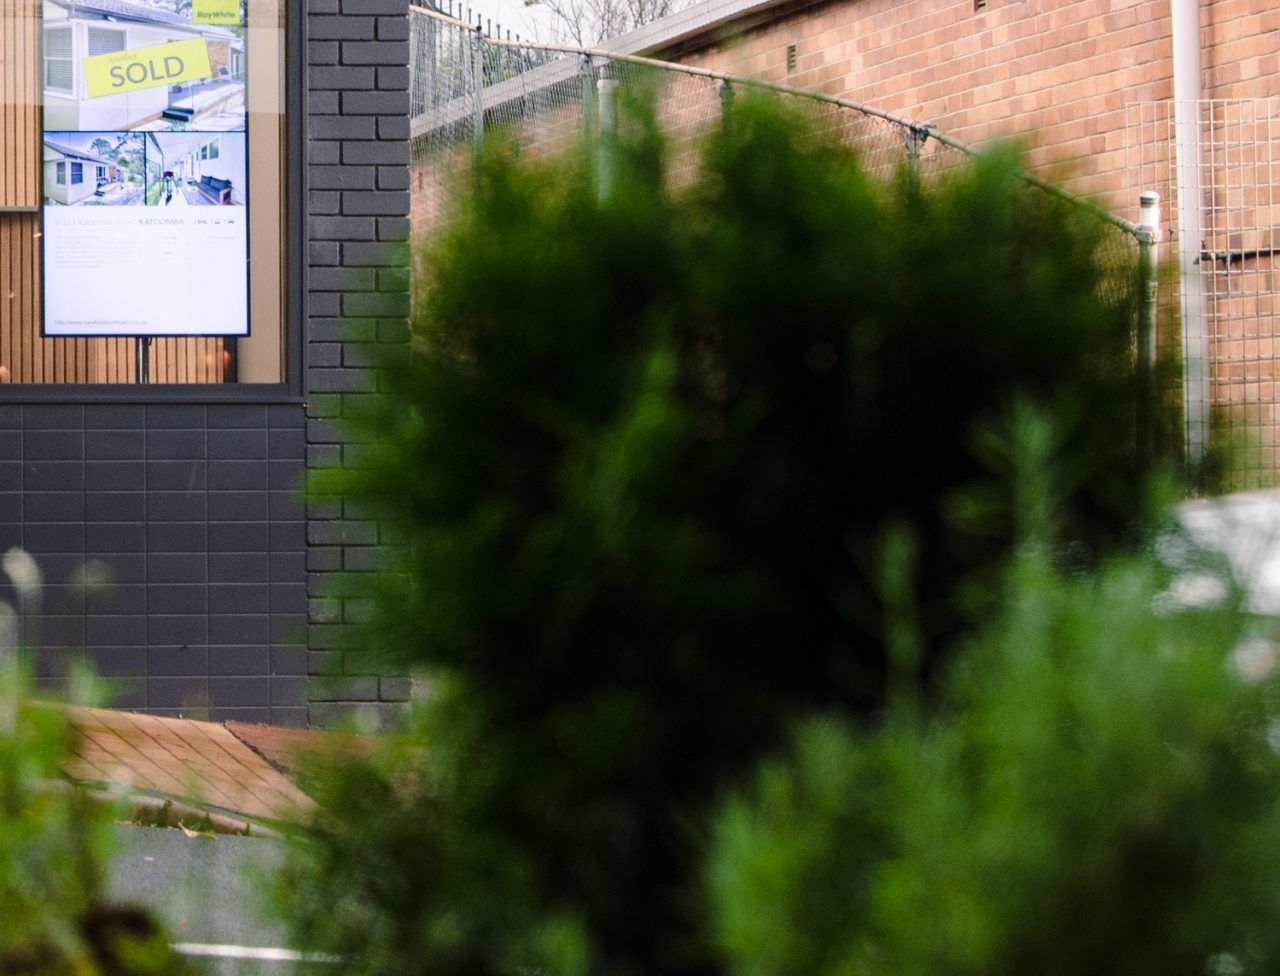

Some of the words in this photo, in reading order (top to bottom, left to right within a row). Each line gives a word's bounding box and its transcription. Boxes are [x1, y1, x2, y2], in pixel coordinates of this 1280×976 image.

[197, 11, 235, 20] RayWhite
[110, 56, 184, 87] SOLD
[138, 217, 184, 226] KATOOMBA
